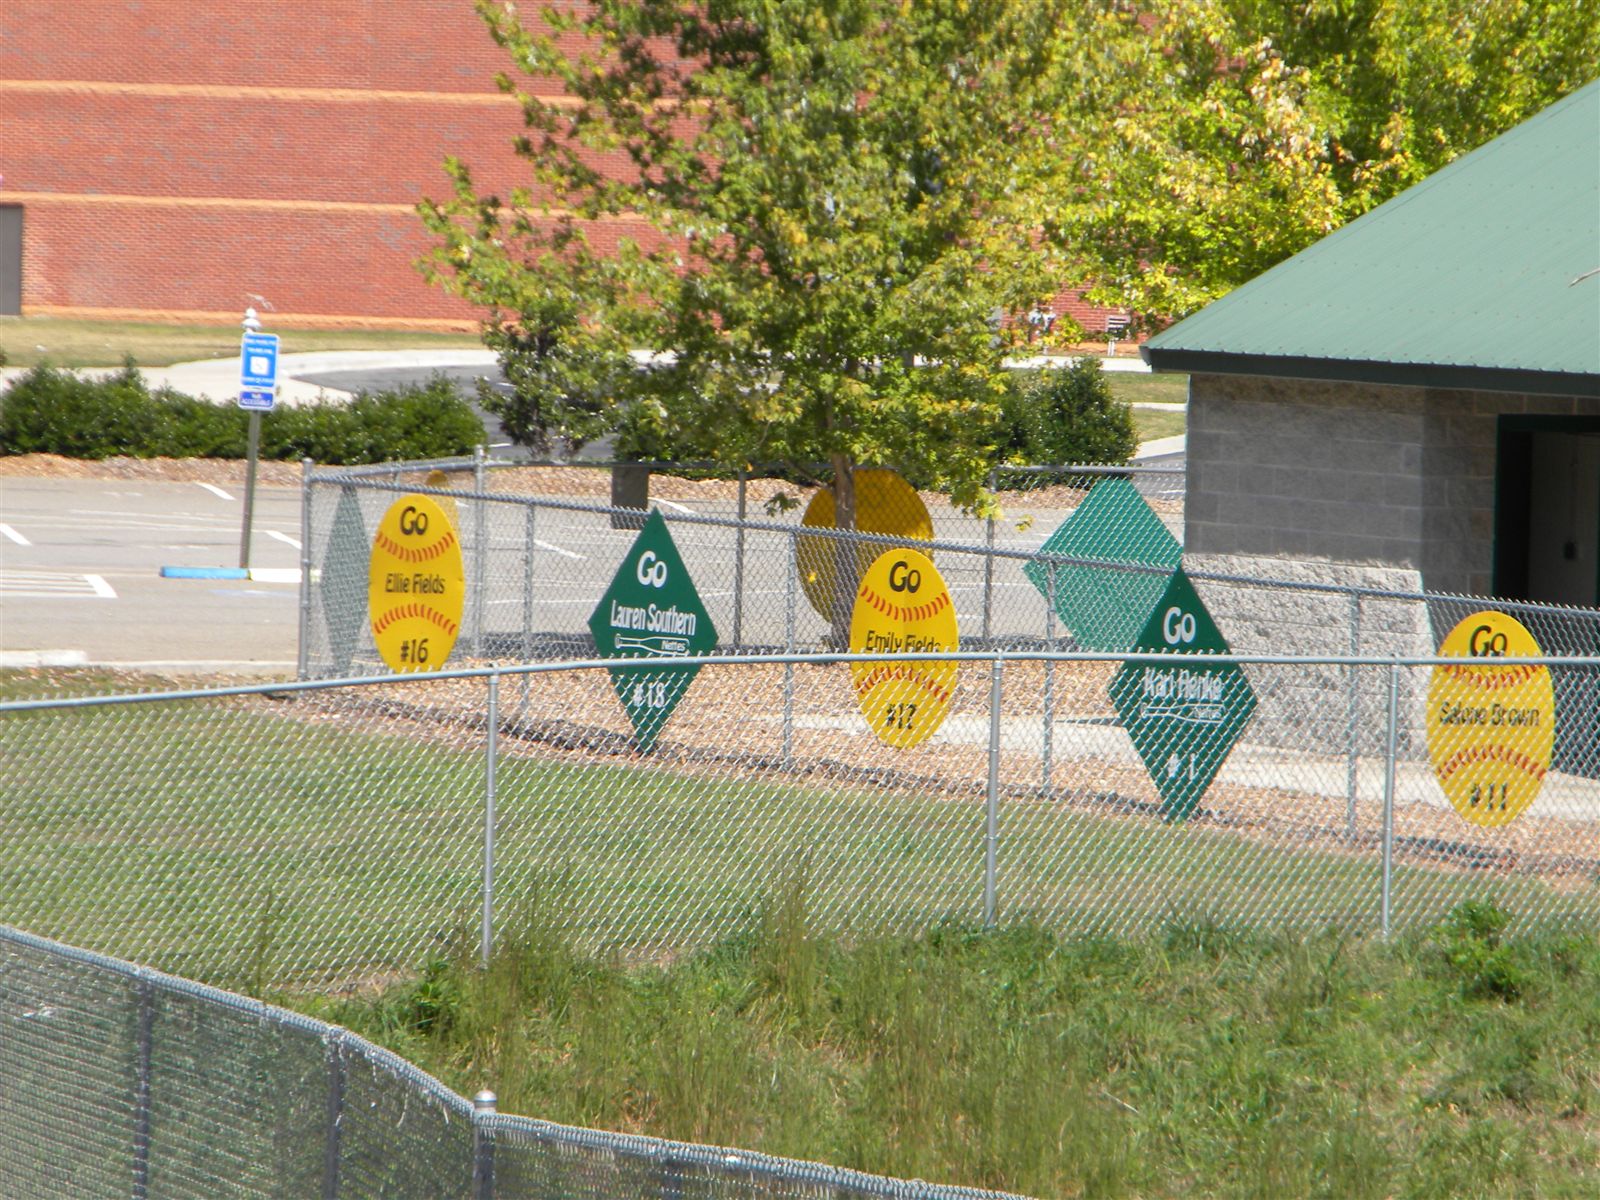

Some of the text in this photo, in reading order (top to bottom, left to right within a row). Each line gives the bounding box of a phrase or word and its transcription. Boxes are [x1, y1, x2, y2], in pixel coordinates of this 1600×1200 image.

[400, 506, 429, 535] Go
[385, 573, 445, 594] Ellie Fields
[637, 550, 667, 588] Go
[889, 561, 921, 593] Go
[610, 600, 697, 636] Lauren Southern
[1164, 606, 1196, 644] Go
[401, 638, 429, 664] #16
[866, 630, 903, 653] Emily
[1469, 625, 1508, 657] Go
[633, 682, 666, 708] #18
[1491, 703, 1540, 726] Brown
